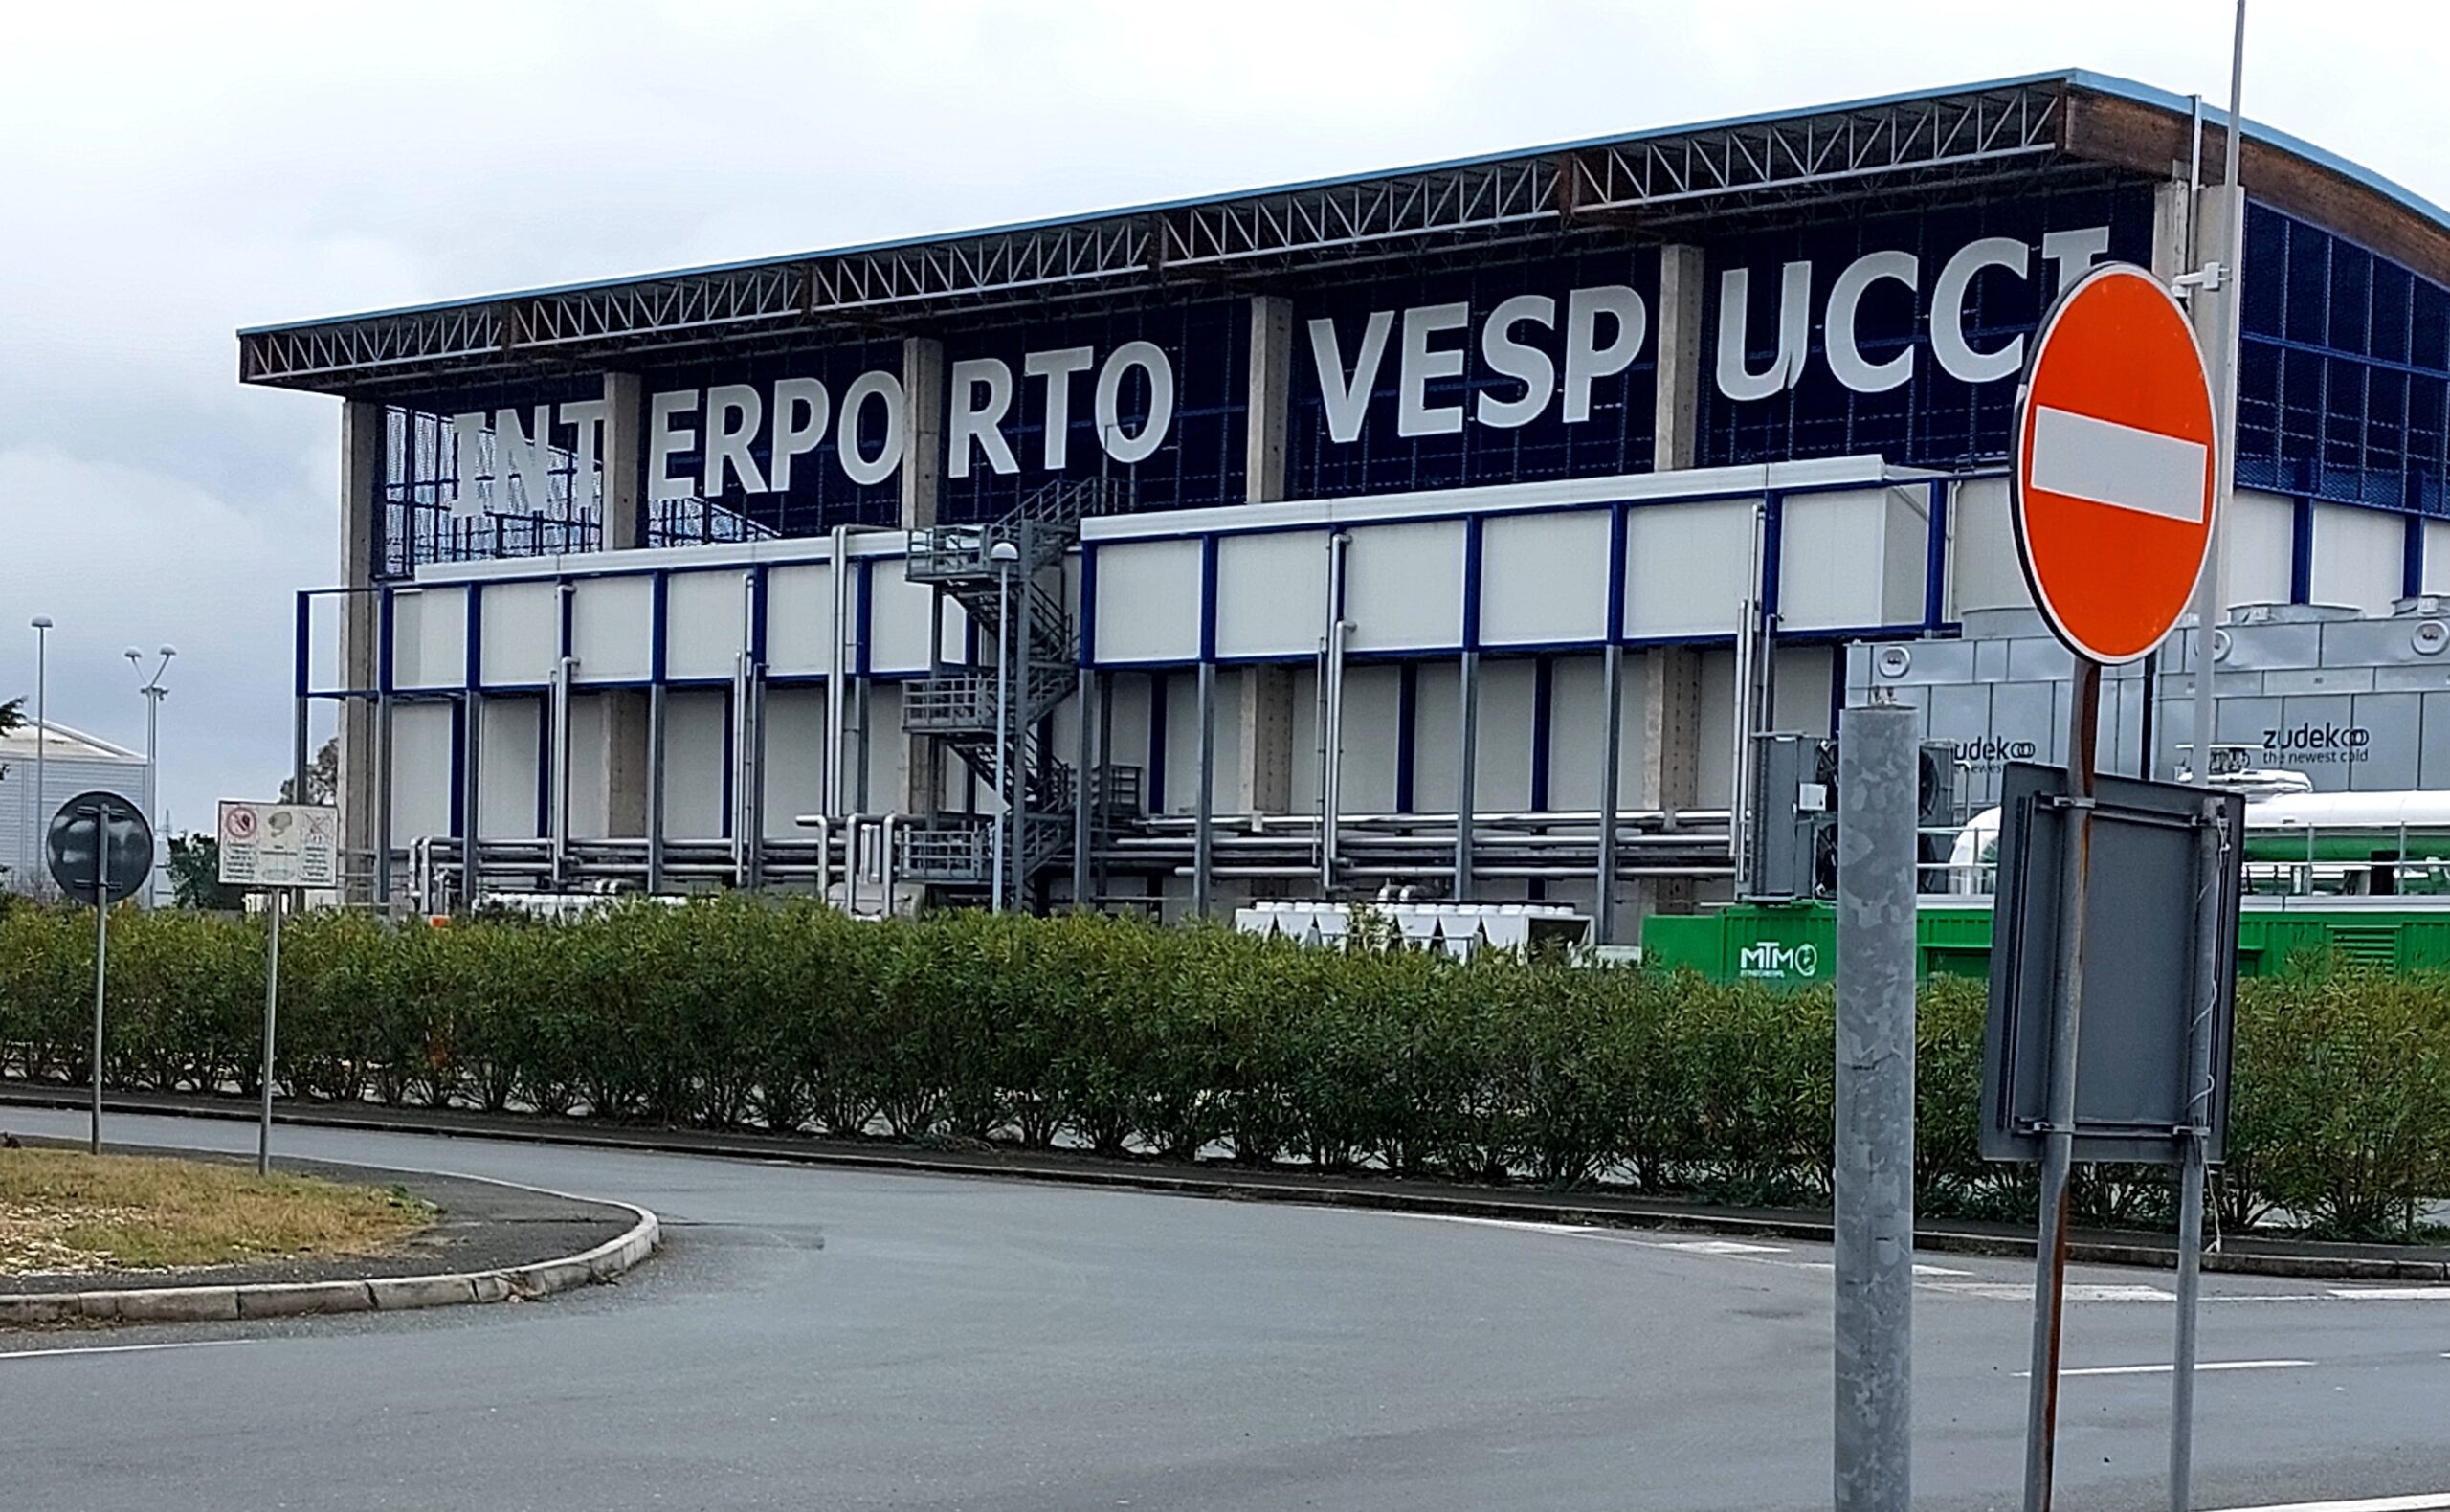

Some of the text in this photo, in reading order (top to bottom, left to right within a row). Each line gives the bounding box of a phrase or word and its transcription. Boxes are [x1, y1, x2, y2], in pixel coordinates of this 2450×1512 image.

[451, 341, 1174, 518] INTERPORTO
[2262, 748, 2369, 765] the newest cold
